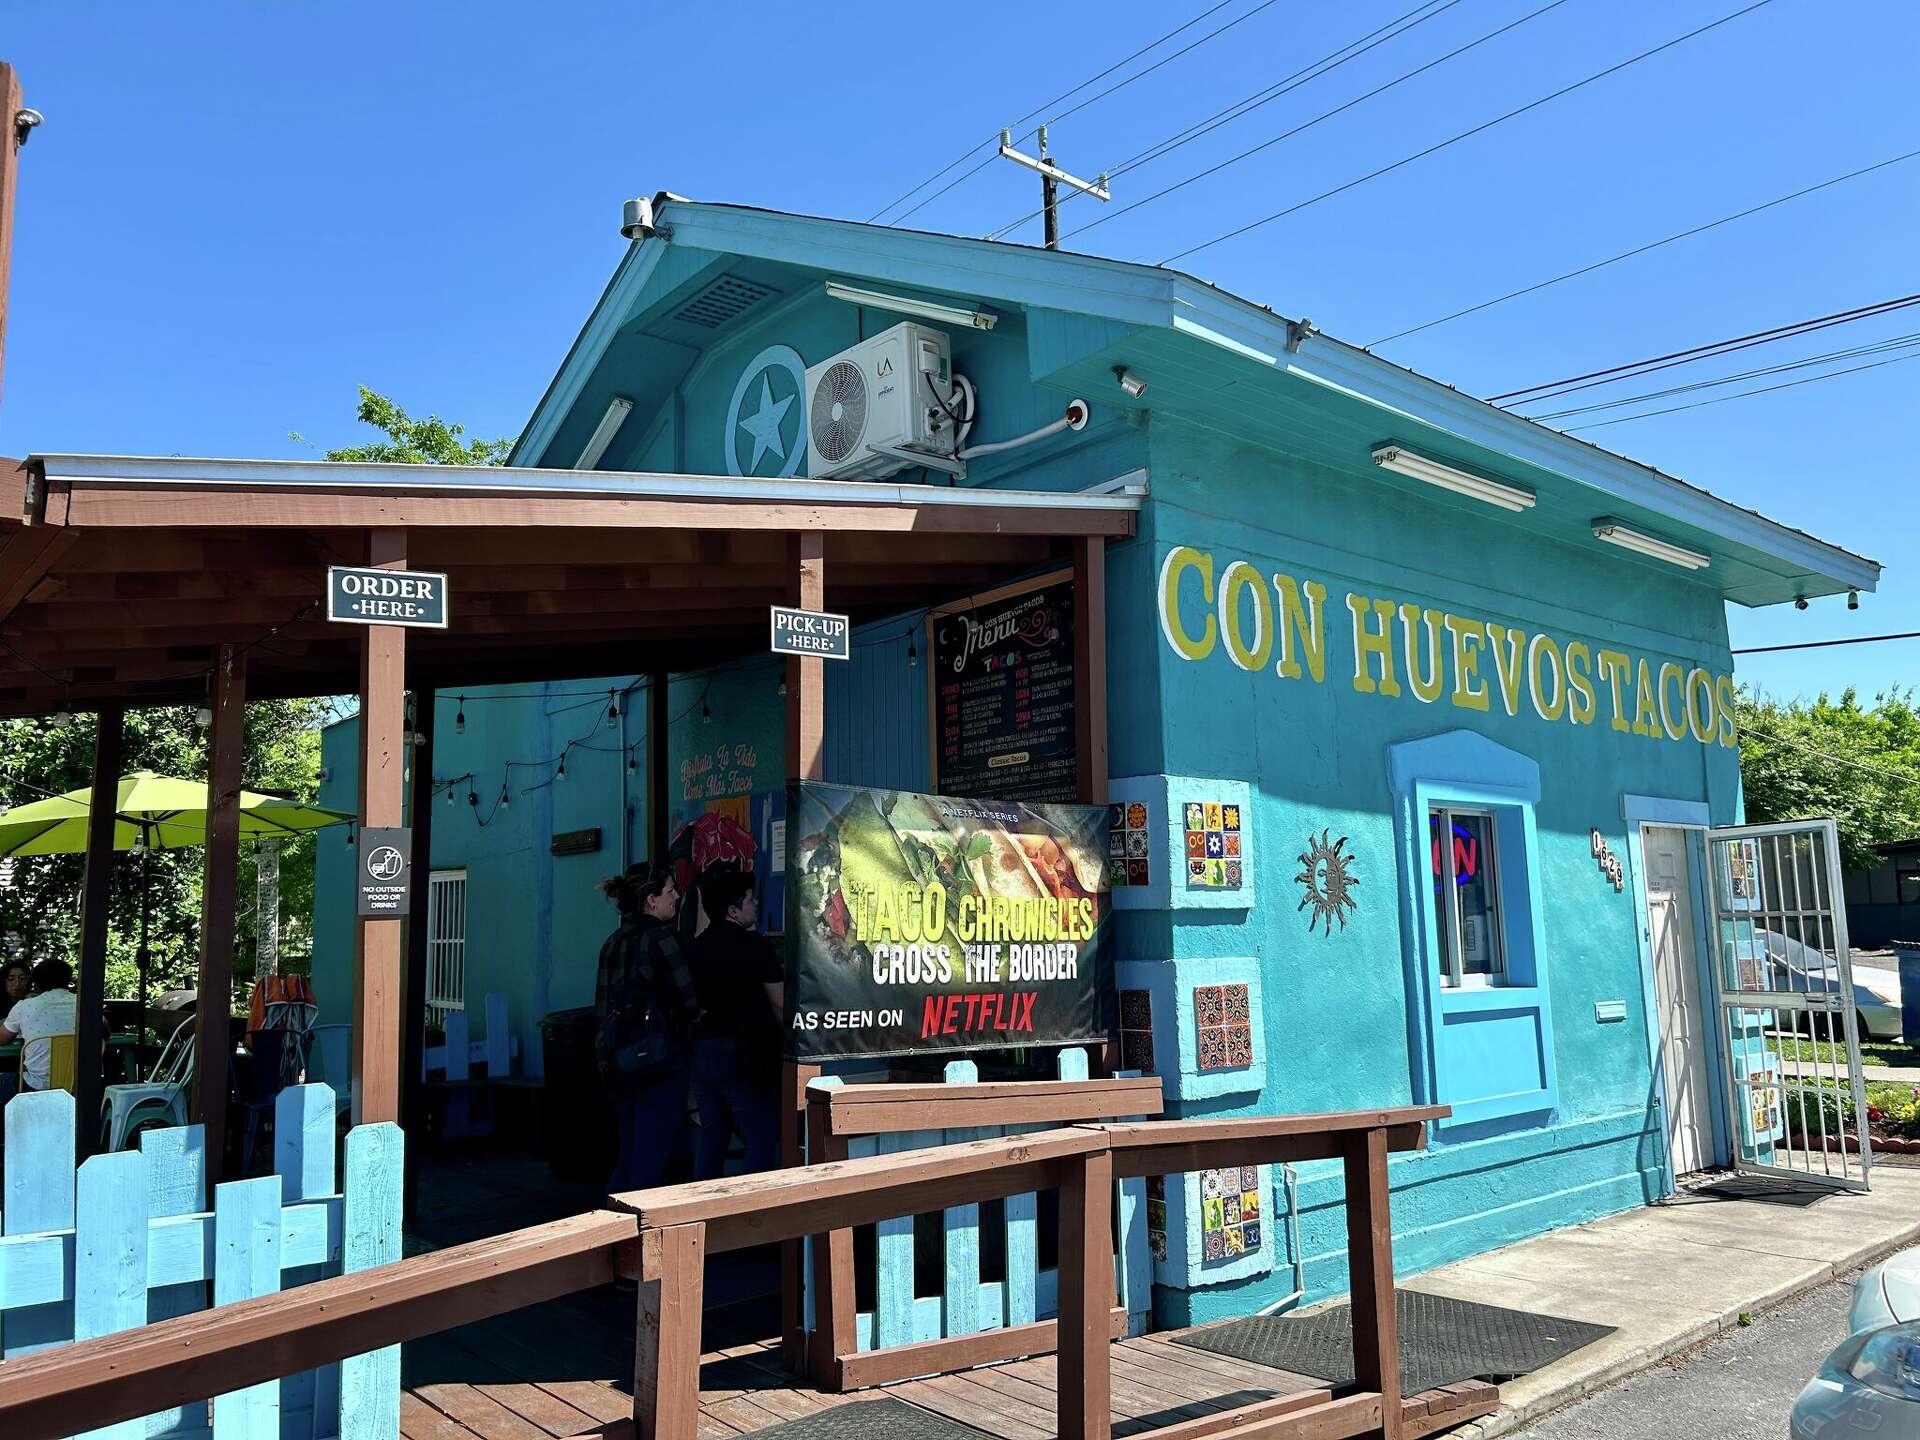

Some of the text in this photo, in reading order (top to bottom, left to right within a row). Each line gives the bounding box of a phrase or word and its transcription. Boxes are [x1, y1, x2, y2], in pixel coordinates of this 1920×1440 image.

[341, 574, 434, 600] ORDER
[360, 599, 417, 618] HERE
[776, 613, 845, 637] PICK-UP
[792, 634, 830, 651] HERE
[954, 615, 1020, 672] Menu
[1158, 546, 1737, 748] CON HUEVOS TACOS
[982, 650, 1023, 673] TACOS
[716, 743, 730, 771] La
[734, 743, 758, 769] Vida
[990, 753, 1029, 767] Classic Tacos
[728, 769, 752, 794] Tacos
[943, 806, 1019, 823] A NETFLIX SERIES
[850, 881, 1093, 942] TACO CHRONICLES
[873, 943, 1078, 985] CROSS THE BORDER
[792, 1009, 902, 1030] AS SEEN ON
[921, 991, 1038, 1039] NETFLIX
